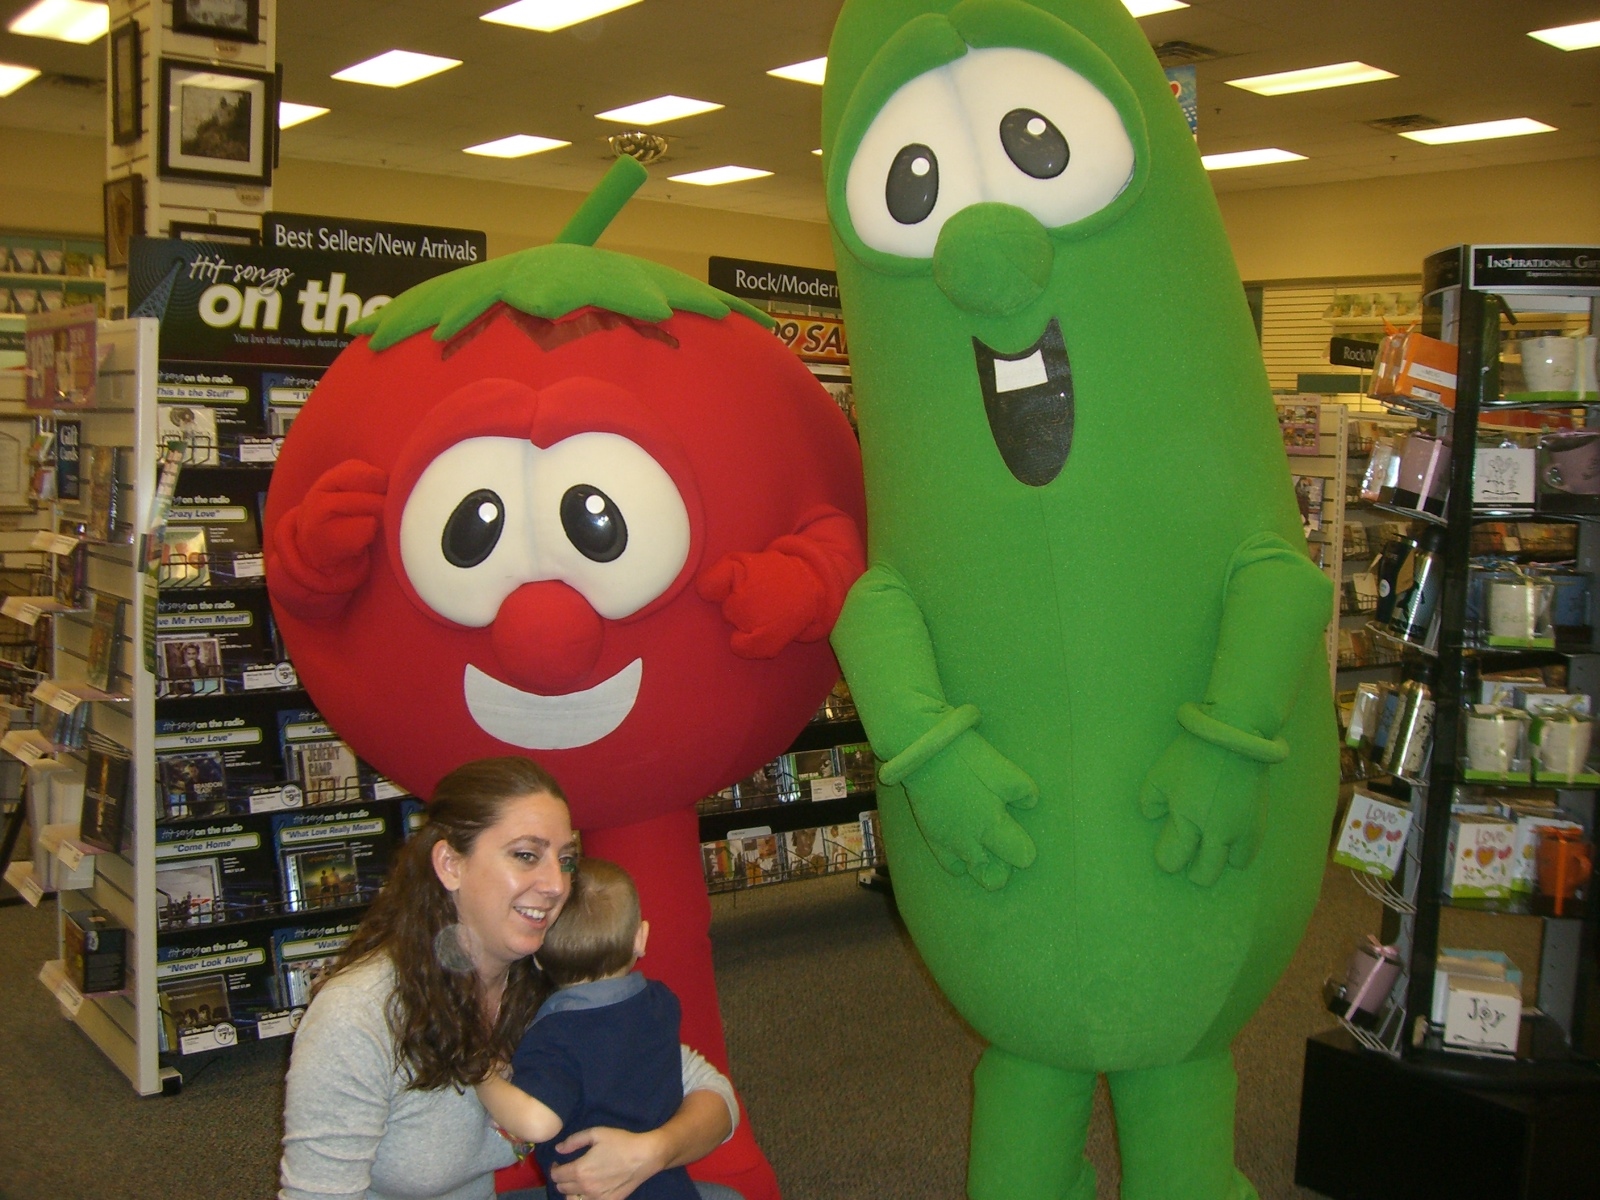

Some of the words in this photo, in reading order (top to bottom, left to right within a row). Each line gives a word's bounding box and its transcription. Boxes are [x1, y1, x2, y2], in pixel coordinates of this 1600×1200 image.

[275, 223, 313, 249] Best
[318, 227, 416, 256] Sellers/New
[420, 236, 478, 262] Arrivals
[189, 253, 233, 283] Hit
[233, 263, 296, 296] songs
[198, 282, 283, 330] on
[234, 333, 249, 344] You
[266, 336, 281, 345] that
[283, 337, 300, 347] song
[302, 339, 316, 348] you
[317, 337, 338, 348] heard
[802, 323, 848, 355] SA
[196, 373, 211, 384] the
[212, 374, 234, 384] radio
[177, 388, 185, 396] Is
[188, 389, 203, 397] the
[194, 495, 208, 504] the
[209, 495, 231, 504] radio
[199, 601, 213, 610] the
[214, 600, 235, 609] radio
[172, 617, 186, 625] Me
[189, 616, 213, 625] From
[196, 721, 208, 729] on
[208, 719, 222, 728] the
[223, 718, 245, 727] radio
[335, 811, 348, 820] the
[349, 809, 370, 819] radio
[207, 826, 221, 834] the
[222, 823, 243, 833] radio
[311, 829, 328, 837] Love
[329, 825, 350, 834] Really
[324, 927, 335, 935] on
[336, 923, 348, 933] the
[212, 942, 227, 951] the
[227, 939, 248, 949] radio
[201, 958, 221, 968] Look
